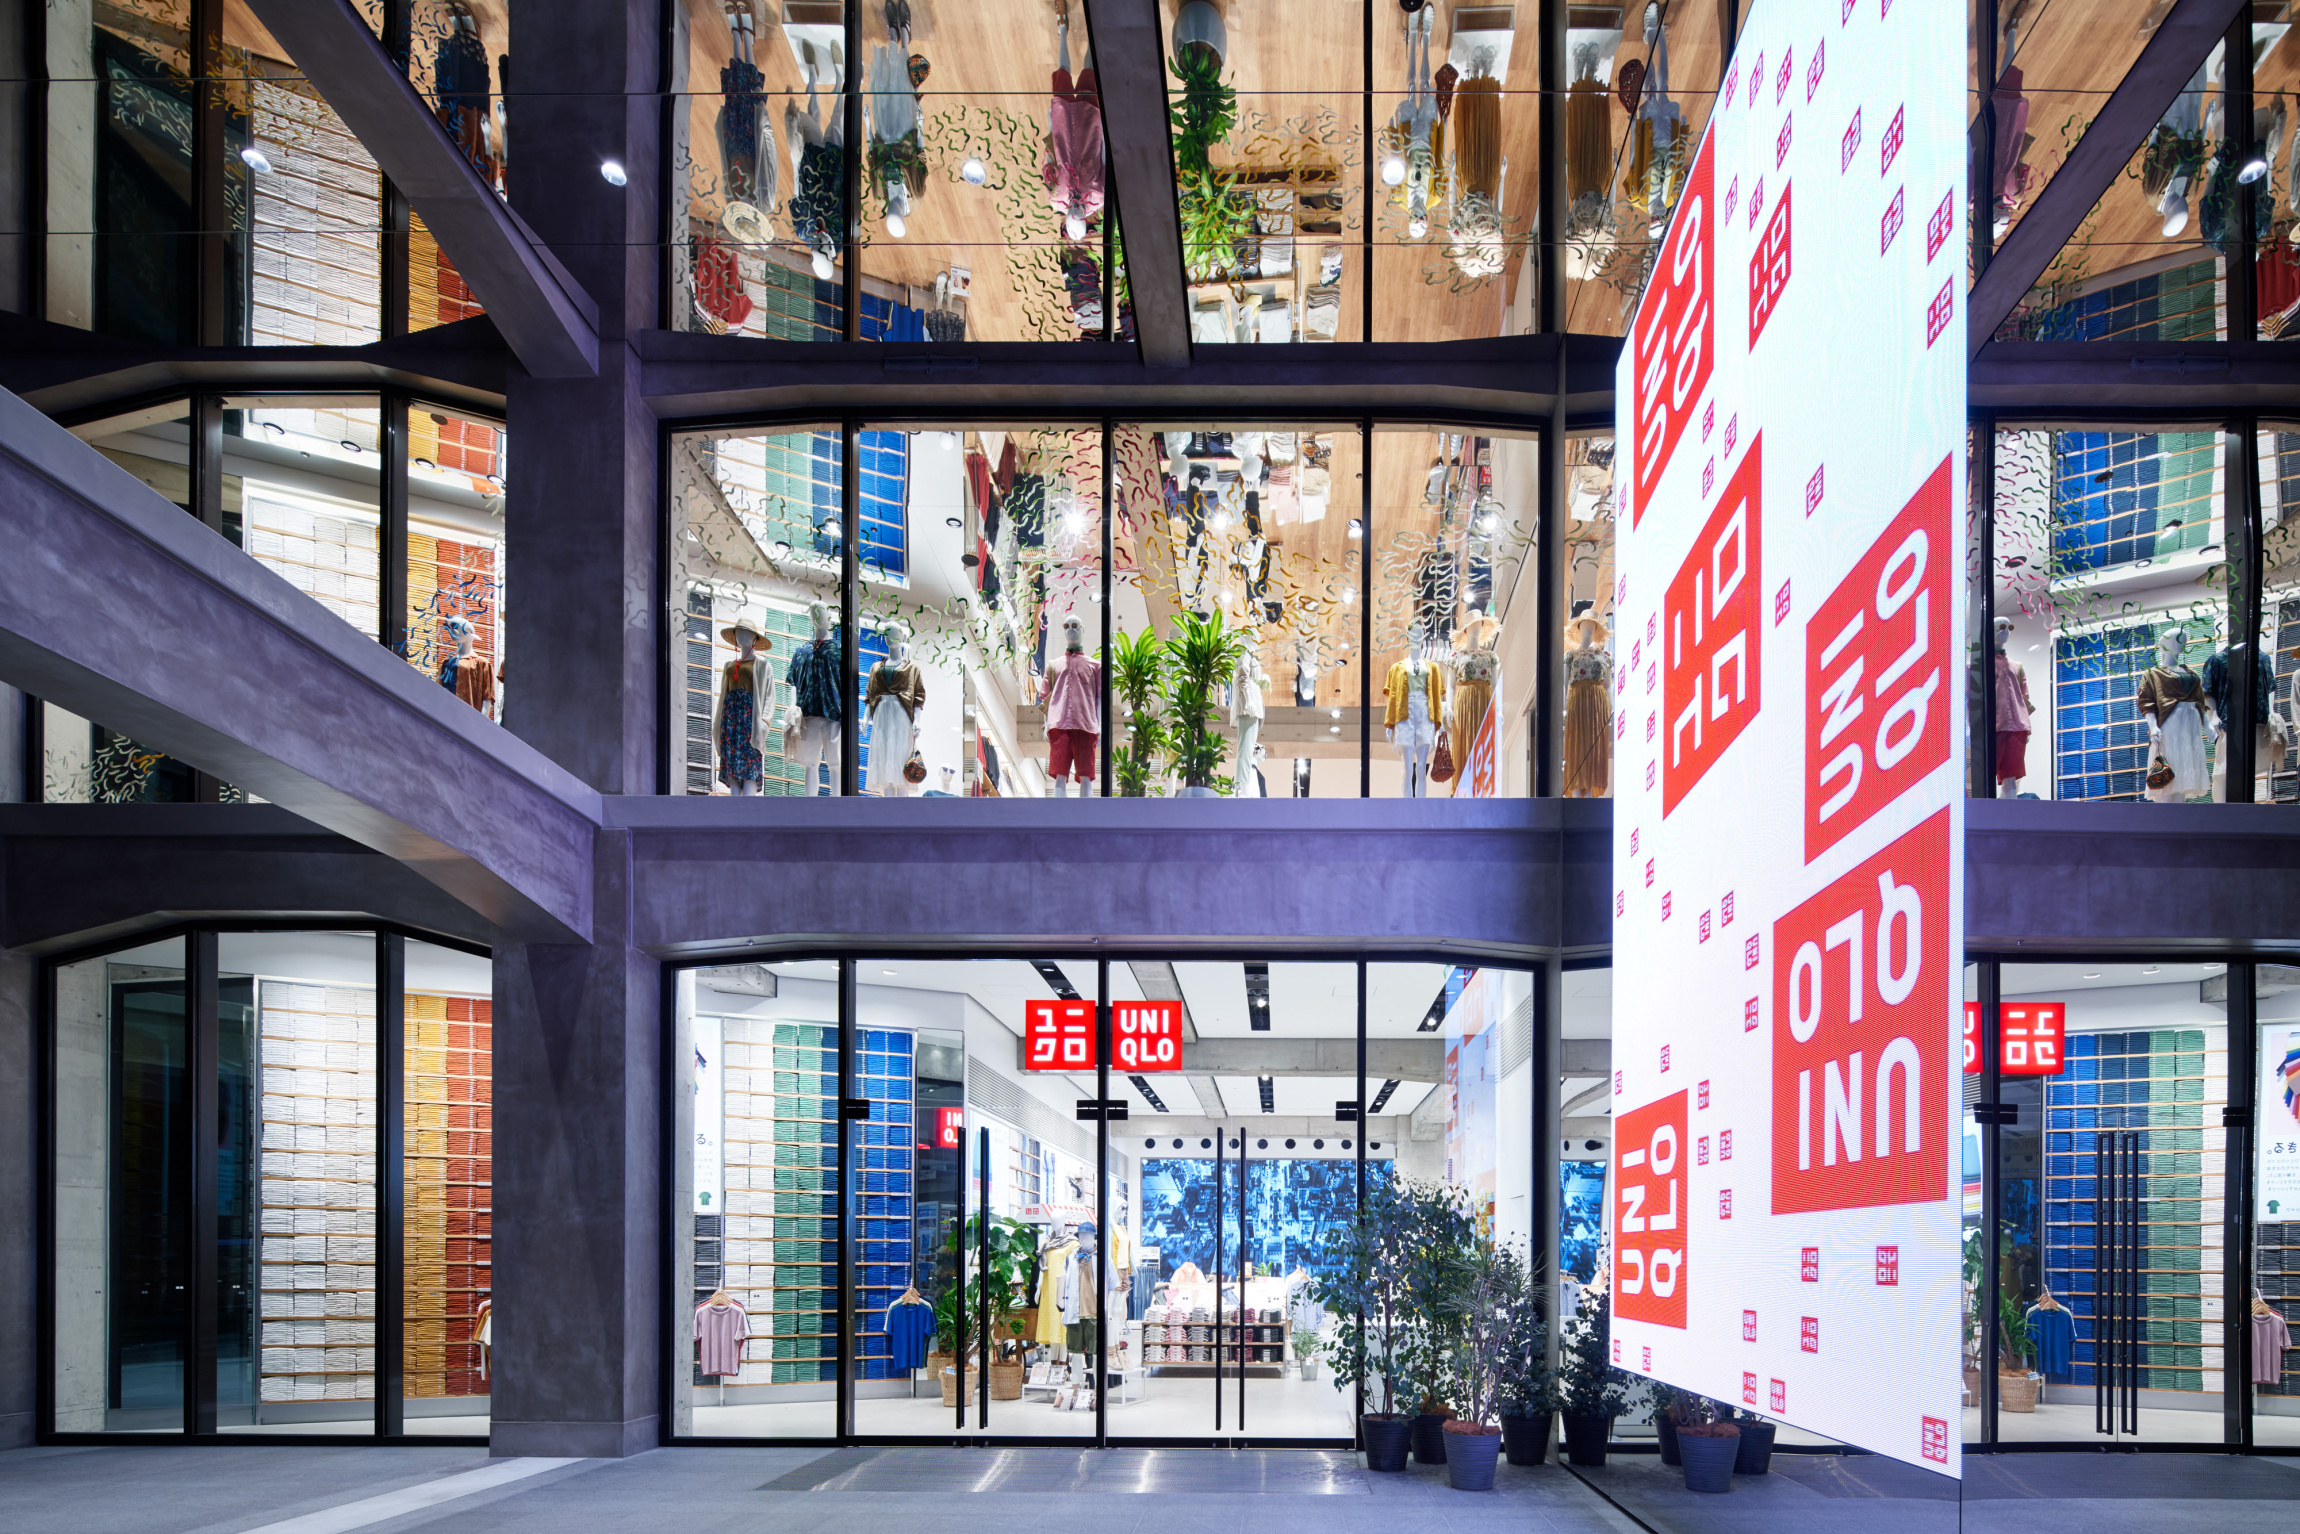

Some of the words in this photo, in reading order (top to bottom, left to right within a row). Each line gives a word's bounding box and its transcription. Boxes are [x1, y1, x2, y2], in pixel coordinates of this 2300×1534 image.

[1642, 288, 1666, 487] UNI
[1673, 195, 1708, 411] QLO
[1673, 568, 1702, 768] ユニ
[1711, 496, 1746, 721] クロ
[1876, 529, 1939, 769] QLO
[1820, 610, 1863, 822] UNI
[1036, 1009, 1085, 1032] ユニ
[1121, 1010, 1168, 1033] UNI
[1788, 870, 1920, 1043] QLO
[1034, 1039, 1085, 1061] クロ
[1121, 1038, 1173, 1066] QLO
[1799, 1038, 1920, 1171] UNI
[1622, 1148, 1644, 1295] UNI
[1650, 1123, 1682, 1298] QLO
